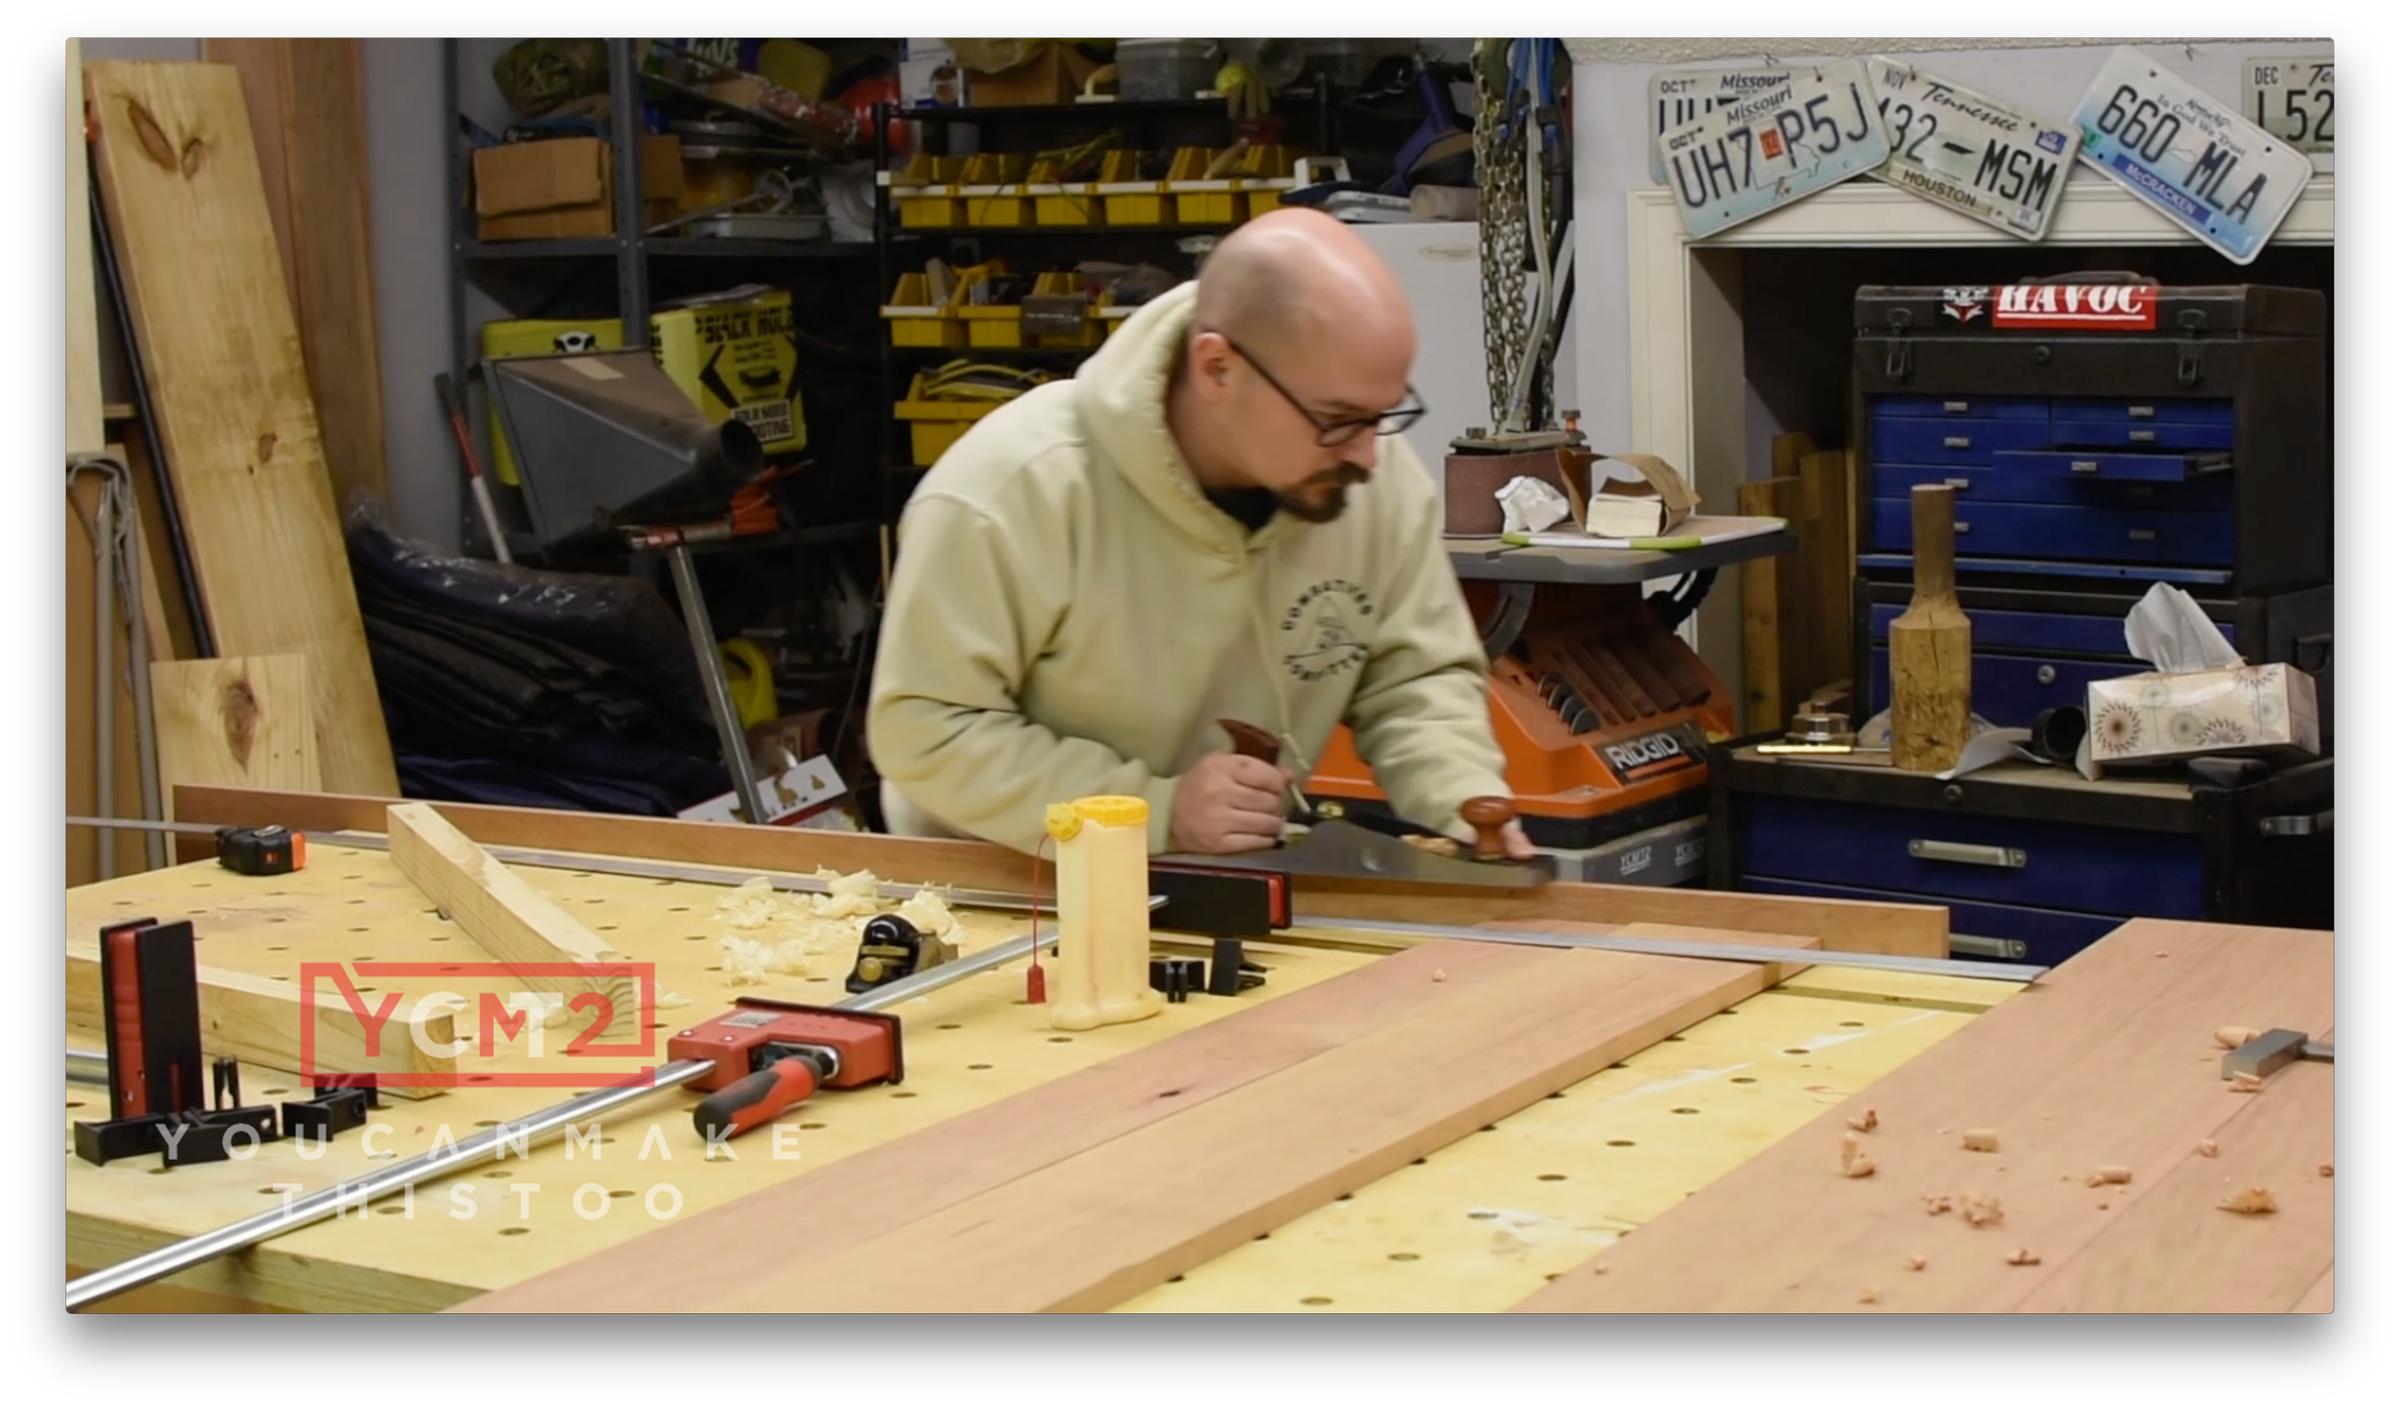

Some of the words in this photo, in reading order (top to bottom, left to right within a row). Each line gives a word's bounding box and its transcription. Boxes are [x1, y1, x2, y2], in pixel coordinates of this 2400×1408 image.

[1661, 79, 1687, 93] OCT
[2254, 66, 2279, 85] DEC
[1726, 84, 1793, 126] Missouri
[1883, 67, 1908, 91] NOV
[1920, 81, 2020, 133] Tennessee
[2171, 103, 2197, 124] God
[1672, 126, 1752, 208] UH7
[1775, 82, 1868, 169] P5J
[1879, 96, 1938, 165] 32
[1973, 138, 2058, 212] MSM
[2096, 84, 2182, 164] 660
[2182, 140, 2268, 225] MLA
[1902, 168, 1978, 208] HOUSTON
[2125, 162, 2198, 216] McCRACKEN
[1997, 285, 2144, 313] HAVOC
[1604, 732, 1681, 770] RIDGID
